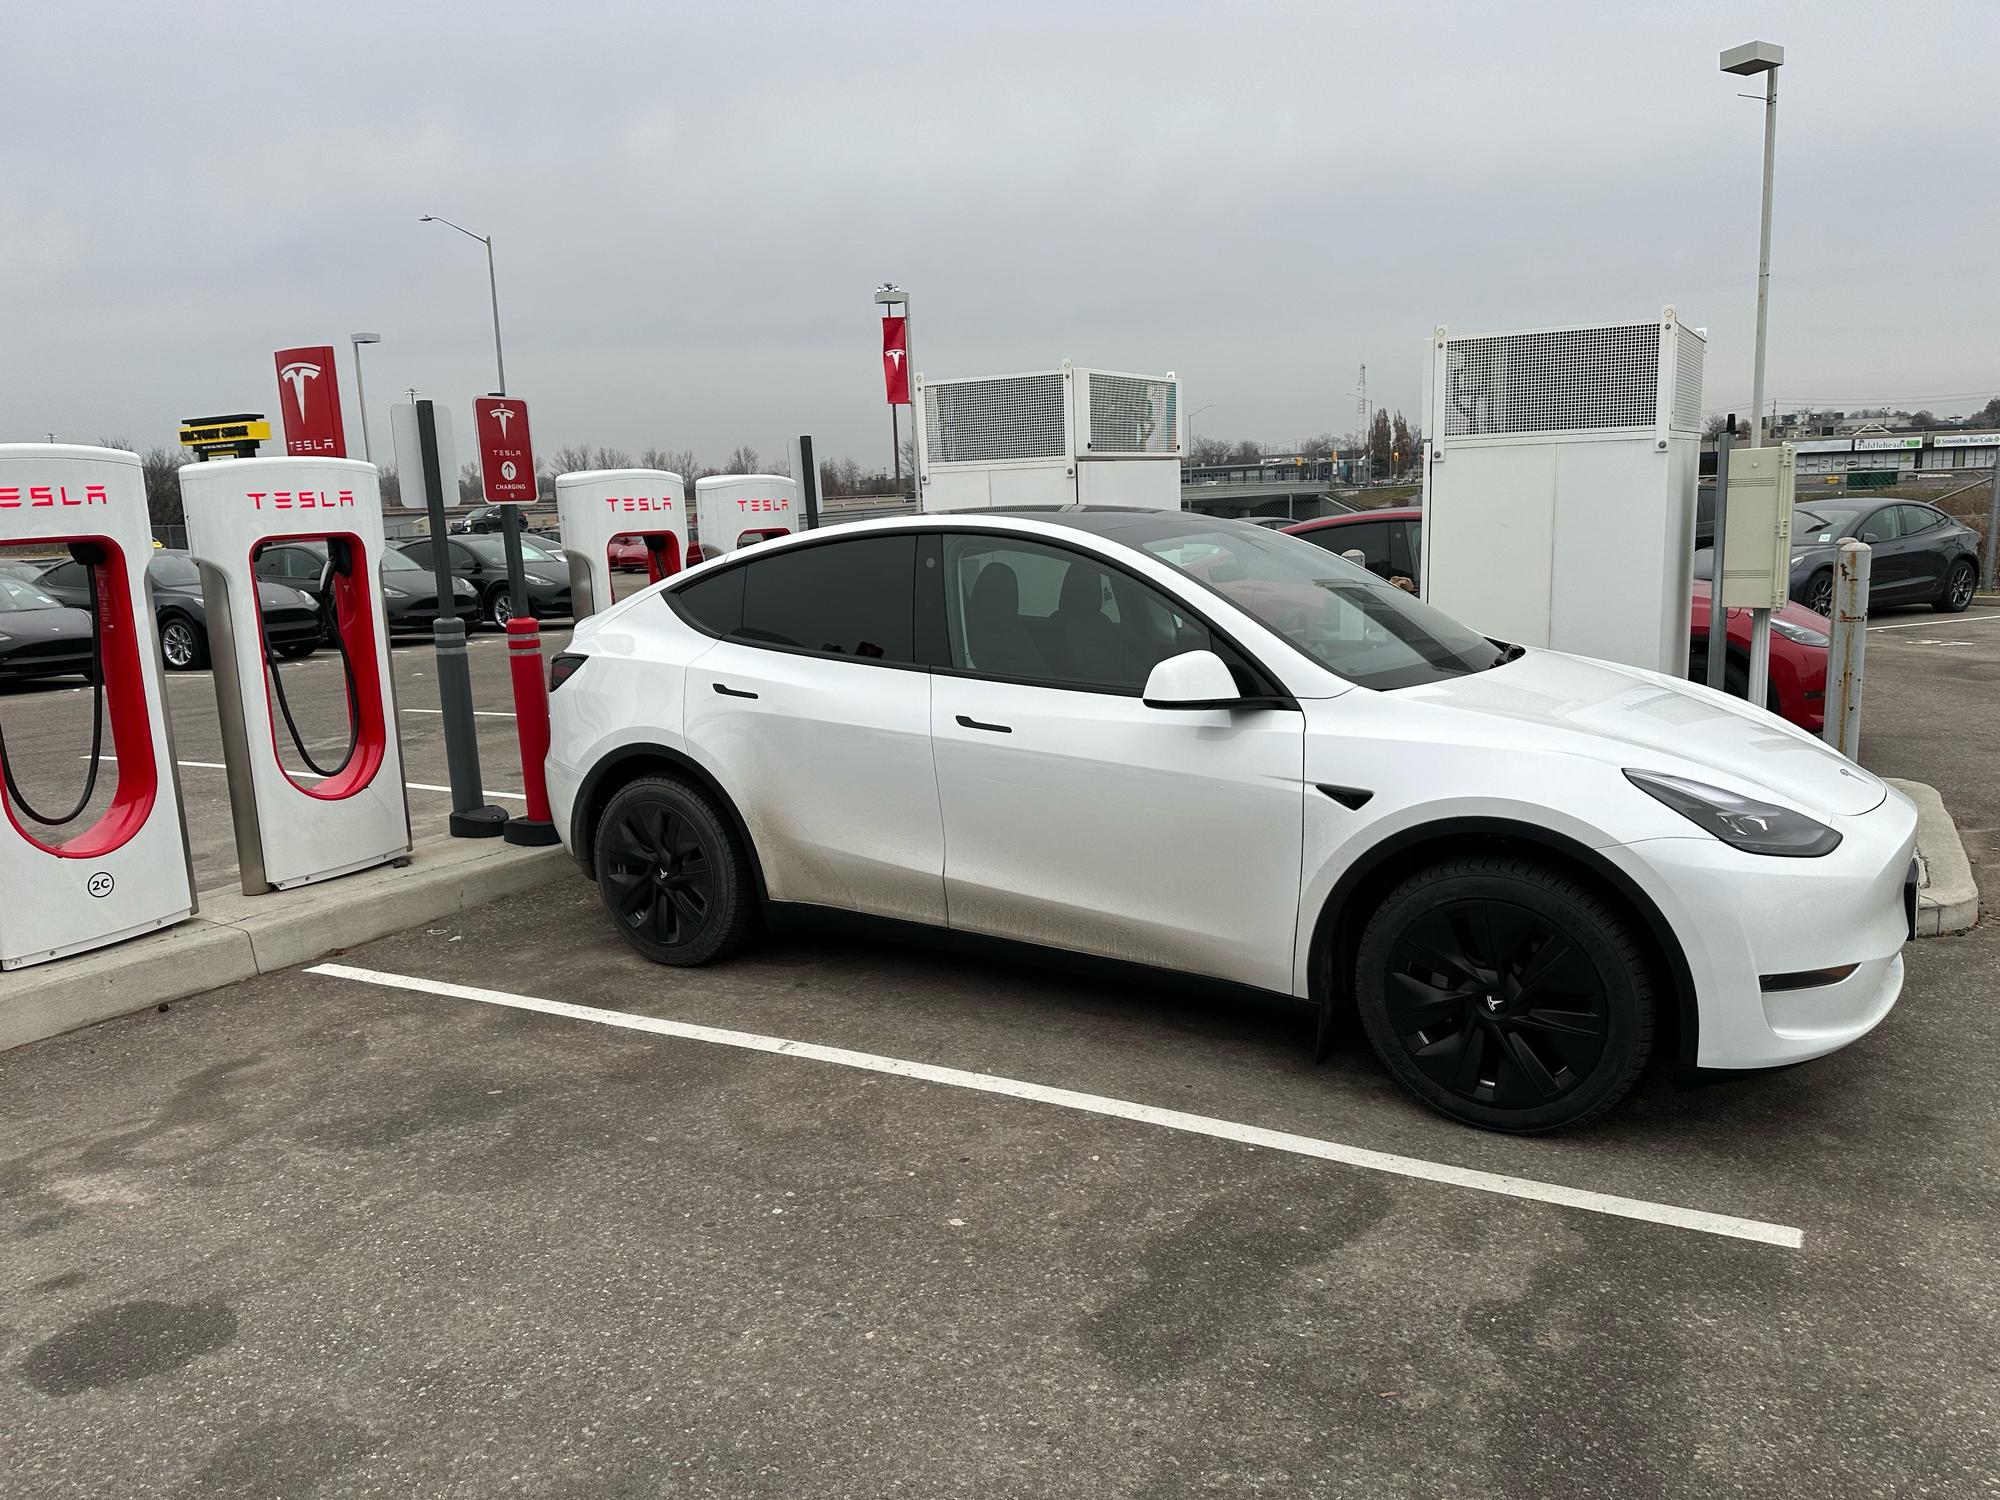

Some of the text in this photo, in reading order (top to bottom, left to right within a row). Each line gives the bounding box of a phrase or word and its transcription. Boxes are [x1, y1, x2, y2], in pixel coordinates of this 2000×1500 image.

[289, 439, 334, 451] TESLA
[0, 485, 107, 507] ESLA
[246, 490, 354, 510] TESLA
[606, 497, 671, 512] TESLA
[737, 499, 789, 512] TESLA
[92, 878, 110, 891] 2C
